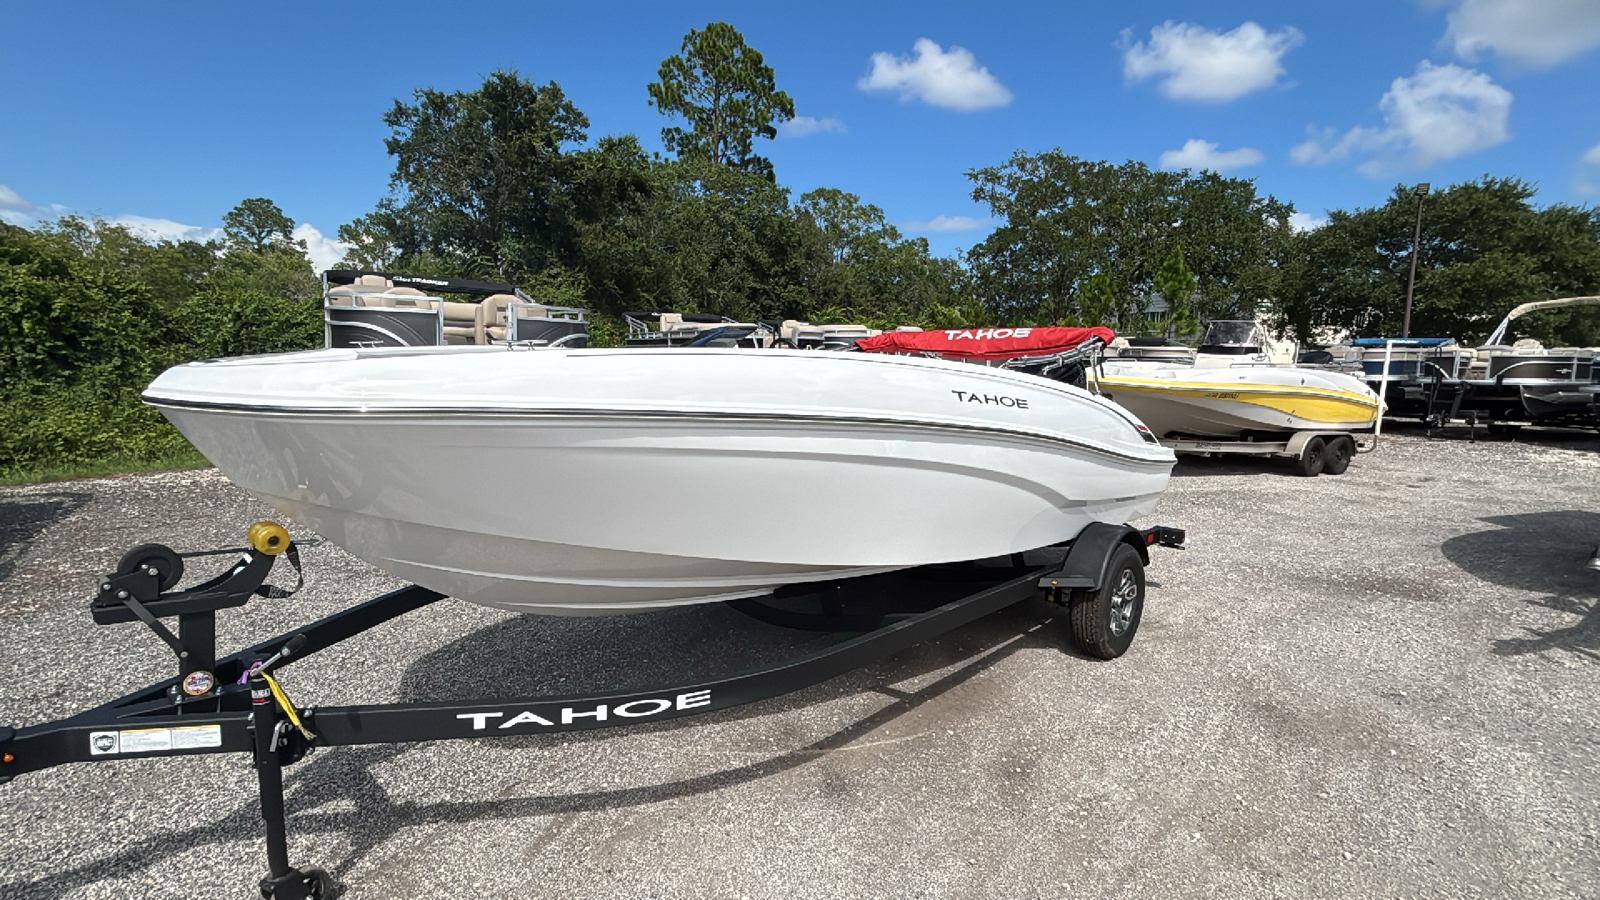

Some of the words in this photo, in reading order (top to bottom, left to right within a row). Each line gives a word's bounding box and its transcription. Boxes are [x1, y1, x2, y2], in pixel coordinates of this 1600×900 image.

[944, 328, 1033, 341] TAHOE
[951, 390, 1029, 409] TAHOE
[456, 689, 712, 730] TAHOE
